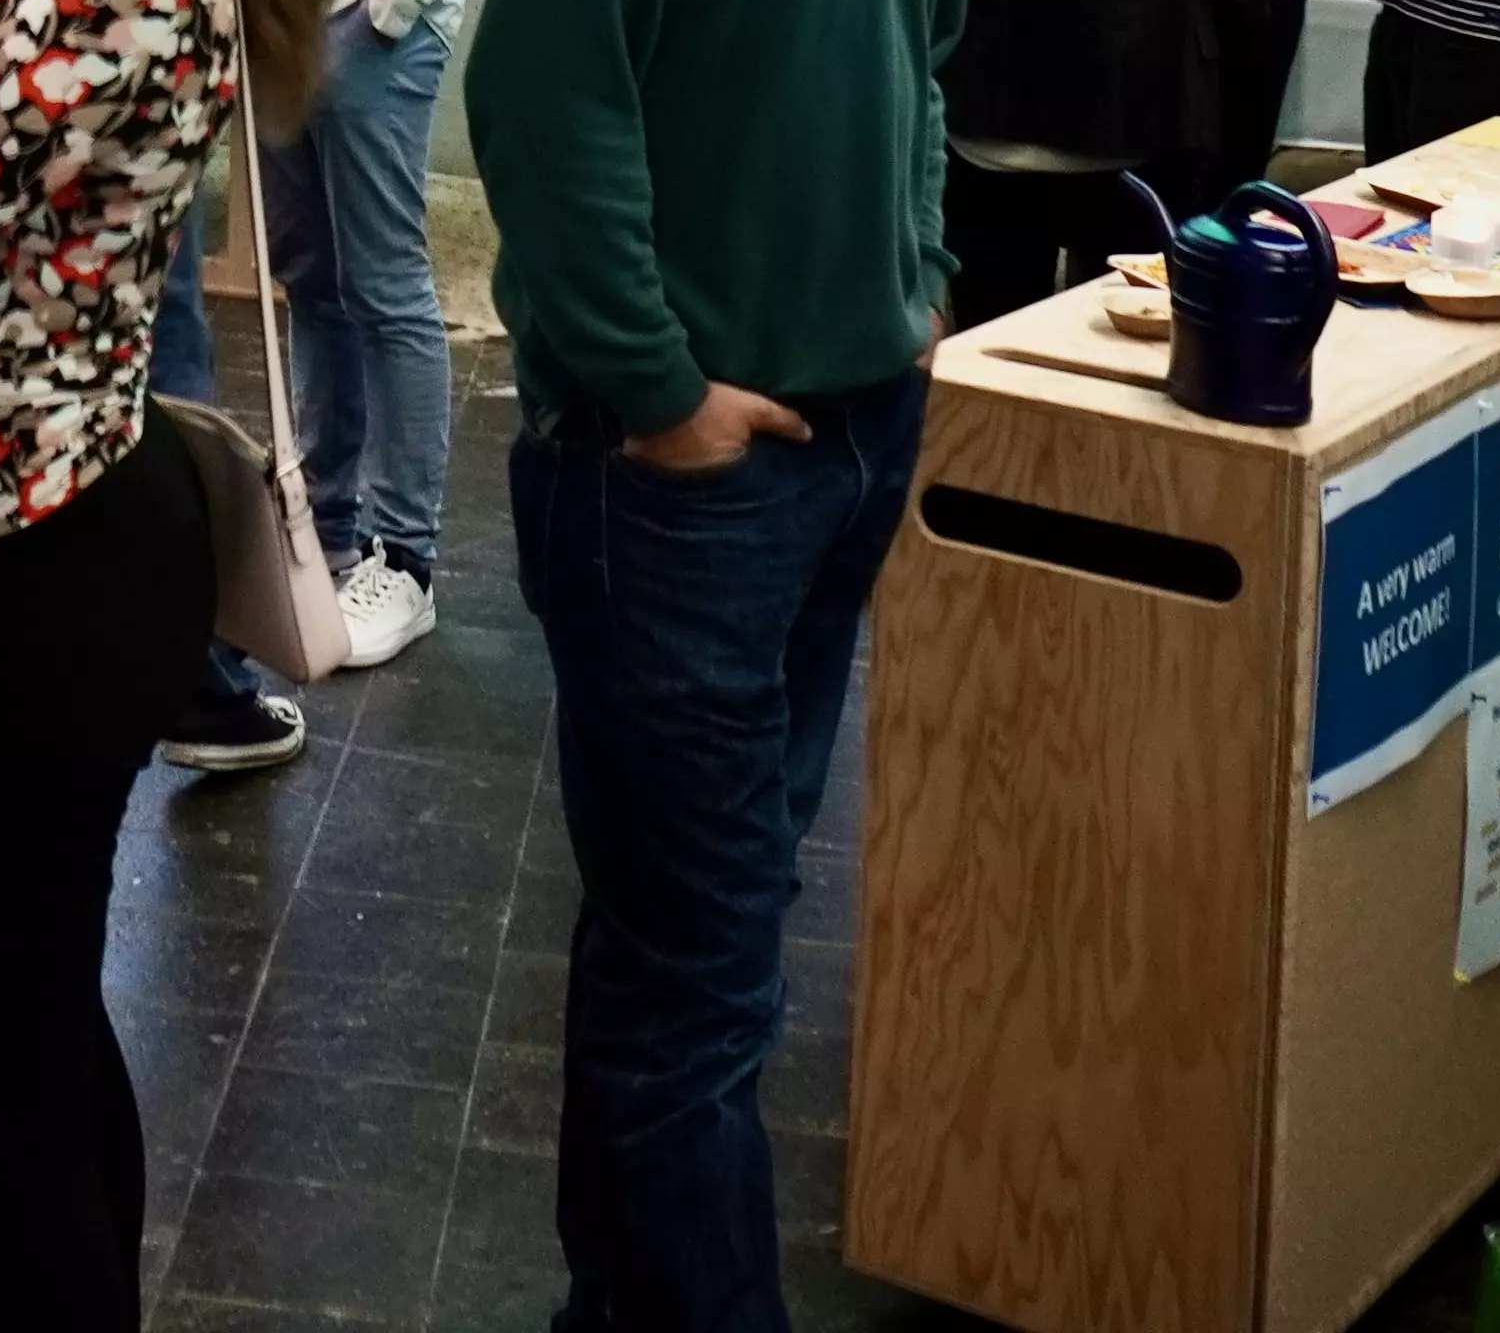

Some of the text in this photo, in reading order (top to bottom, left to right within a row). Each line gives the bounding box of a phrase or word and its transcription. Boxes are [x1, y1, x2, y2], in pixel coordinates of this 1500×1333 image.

[1356, 531, 1456, 620] A very warm
[1362, 585, 1451, 676] WELCOME!
